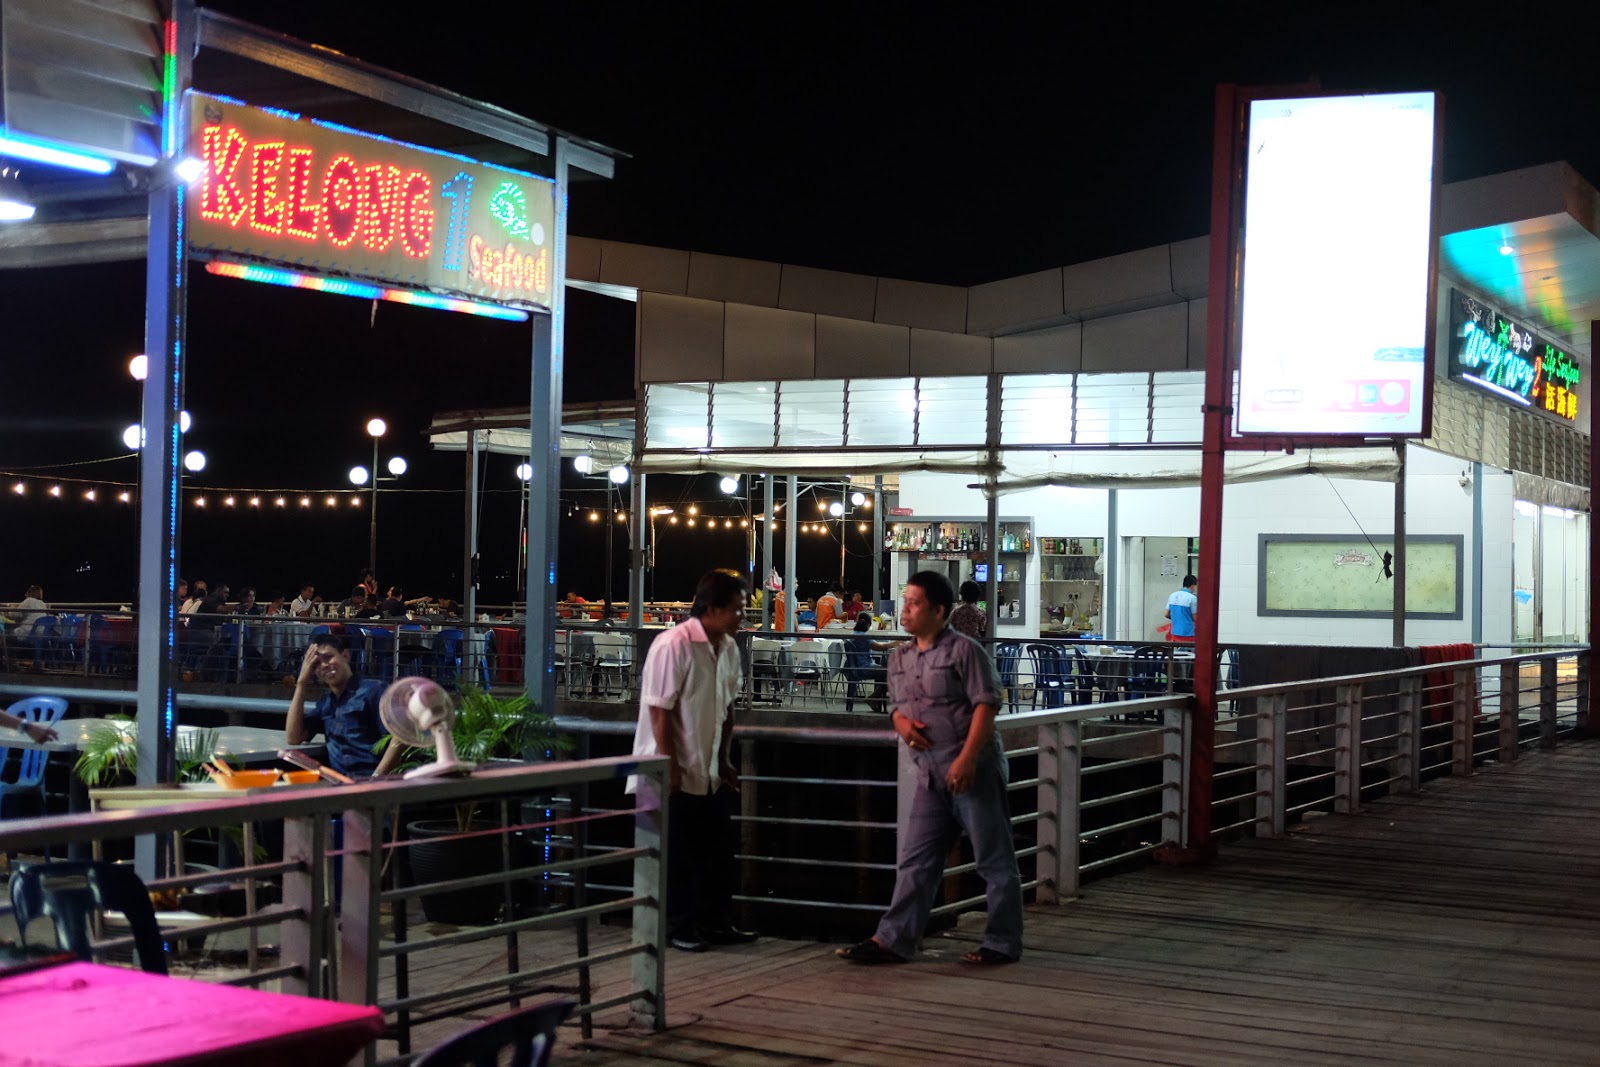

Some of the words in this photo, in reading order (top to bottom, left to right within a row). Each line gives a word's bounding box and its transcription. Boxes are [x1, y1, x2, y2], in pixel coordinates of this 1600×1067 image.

[201, 125, 434, 259] KELONG
[441, 171, 474, 272] 1
[468, 234, 547, 294] Seafood
[1463, 320, 1501, 382] Wey
[1532, 355, 1542, 397] 2
